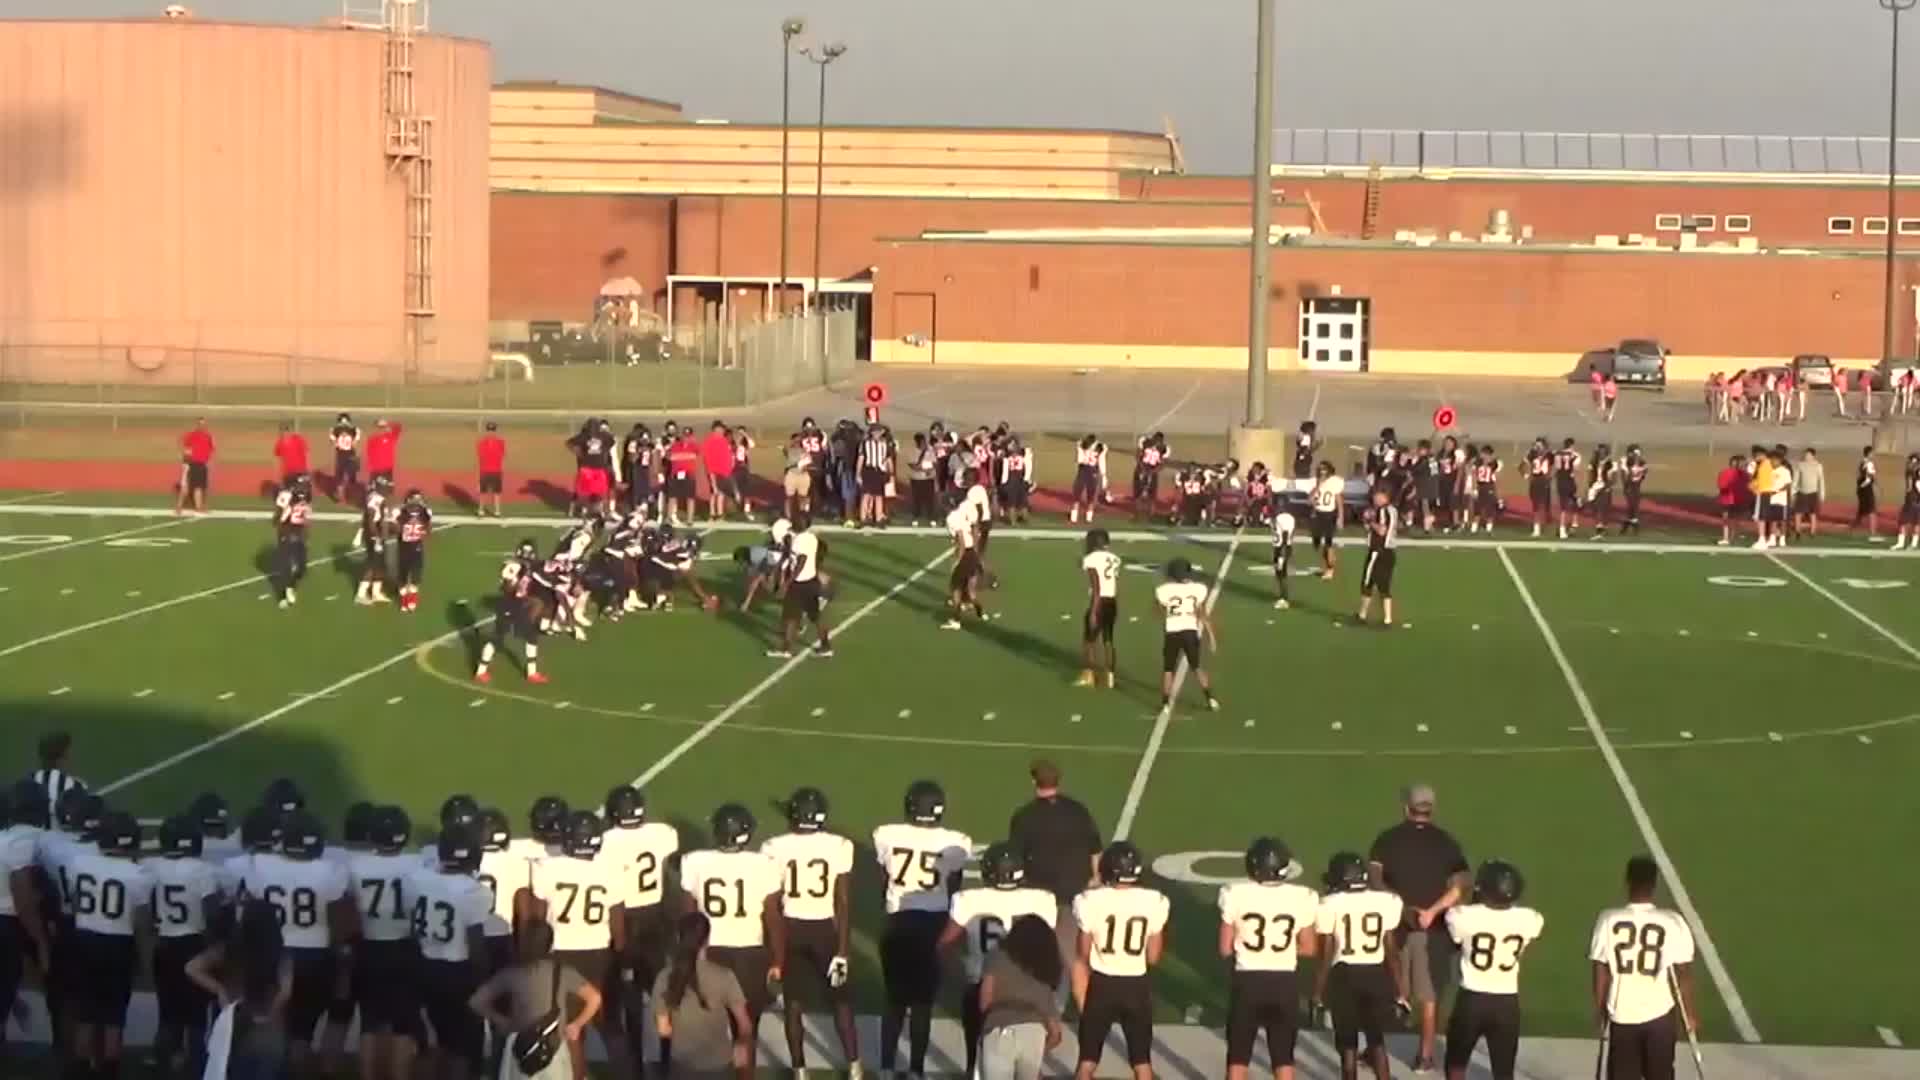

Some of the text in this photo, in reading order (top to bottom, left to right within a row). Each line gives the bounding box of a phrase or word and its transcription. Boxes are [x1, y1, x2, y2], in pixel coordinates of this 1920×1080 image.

[1168, 596, 1198, 617] 23
[636, 851, 658, 893] 2
[786, 858, 829, 899] 13
[892, 847, 944, 890] 75
[76, 872, 125, 919] 60
[263, 884, 317, 928] 68
[361, 878, 408, 921] 71
[555, 882, 608, 925] 76
[703, 877, 747, 918] 61
[411, 895, 455, 944] 43
[1100, 914, 1148, 956] 10
[1242, 912, 1296, 953] 33
[1341, 912, 1383, 956] 19
[1470, 932, 1524, 972] 83
[1612, 920, 1666, 976] 28
